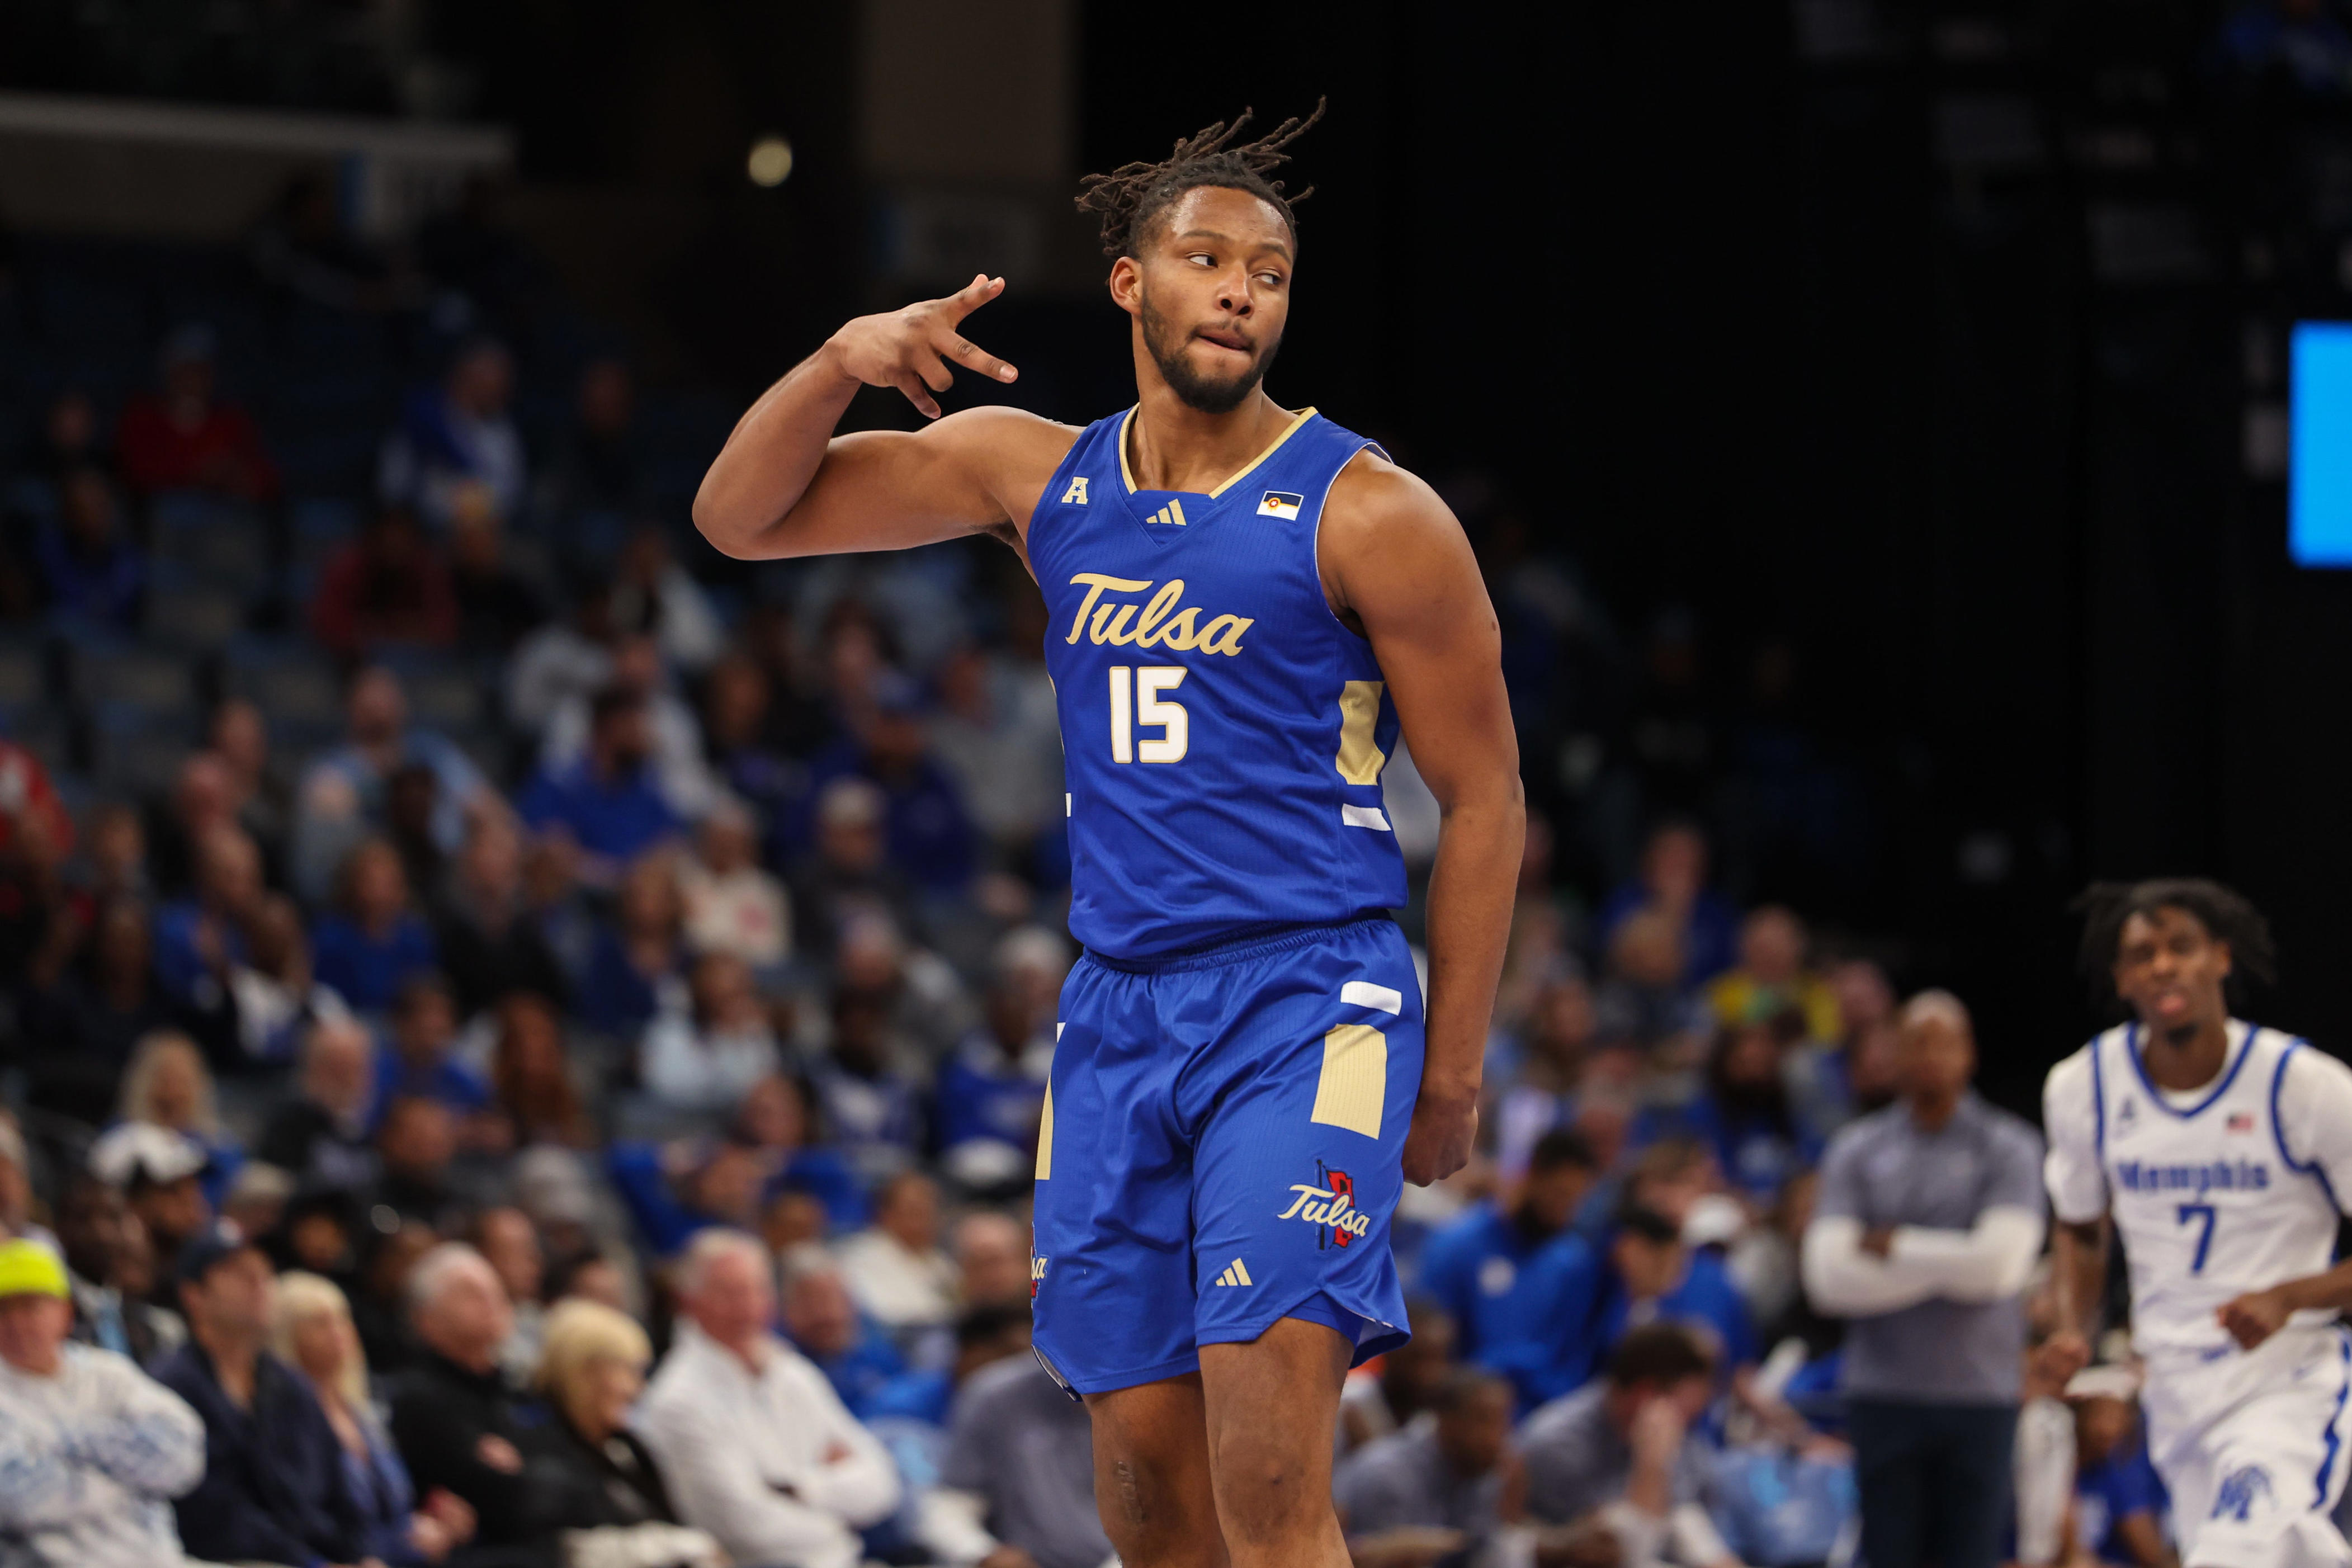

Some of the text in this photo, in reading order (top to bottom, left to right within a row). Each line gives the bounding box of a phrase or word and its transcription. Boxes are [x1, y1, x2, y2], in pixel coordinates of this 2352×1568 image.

[1061, 476, 1089, 505] A
[1065, 573, 1254, 657] Tulsa
[1109, 666, 1188, 763] 15
[1277, 1184, 1369, 1237] Tulsa
[2176, 1203, 2217, 1273] 7
